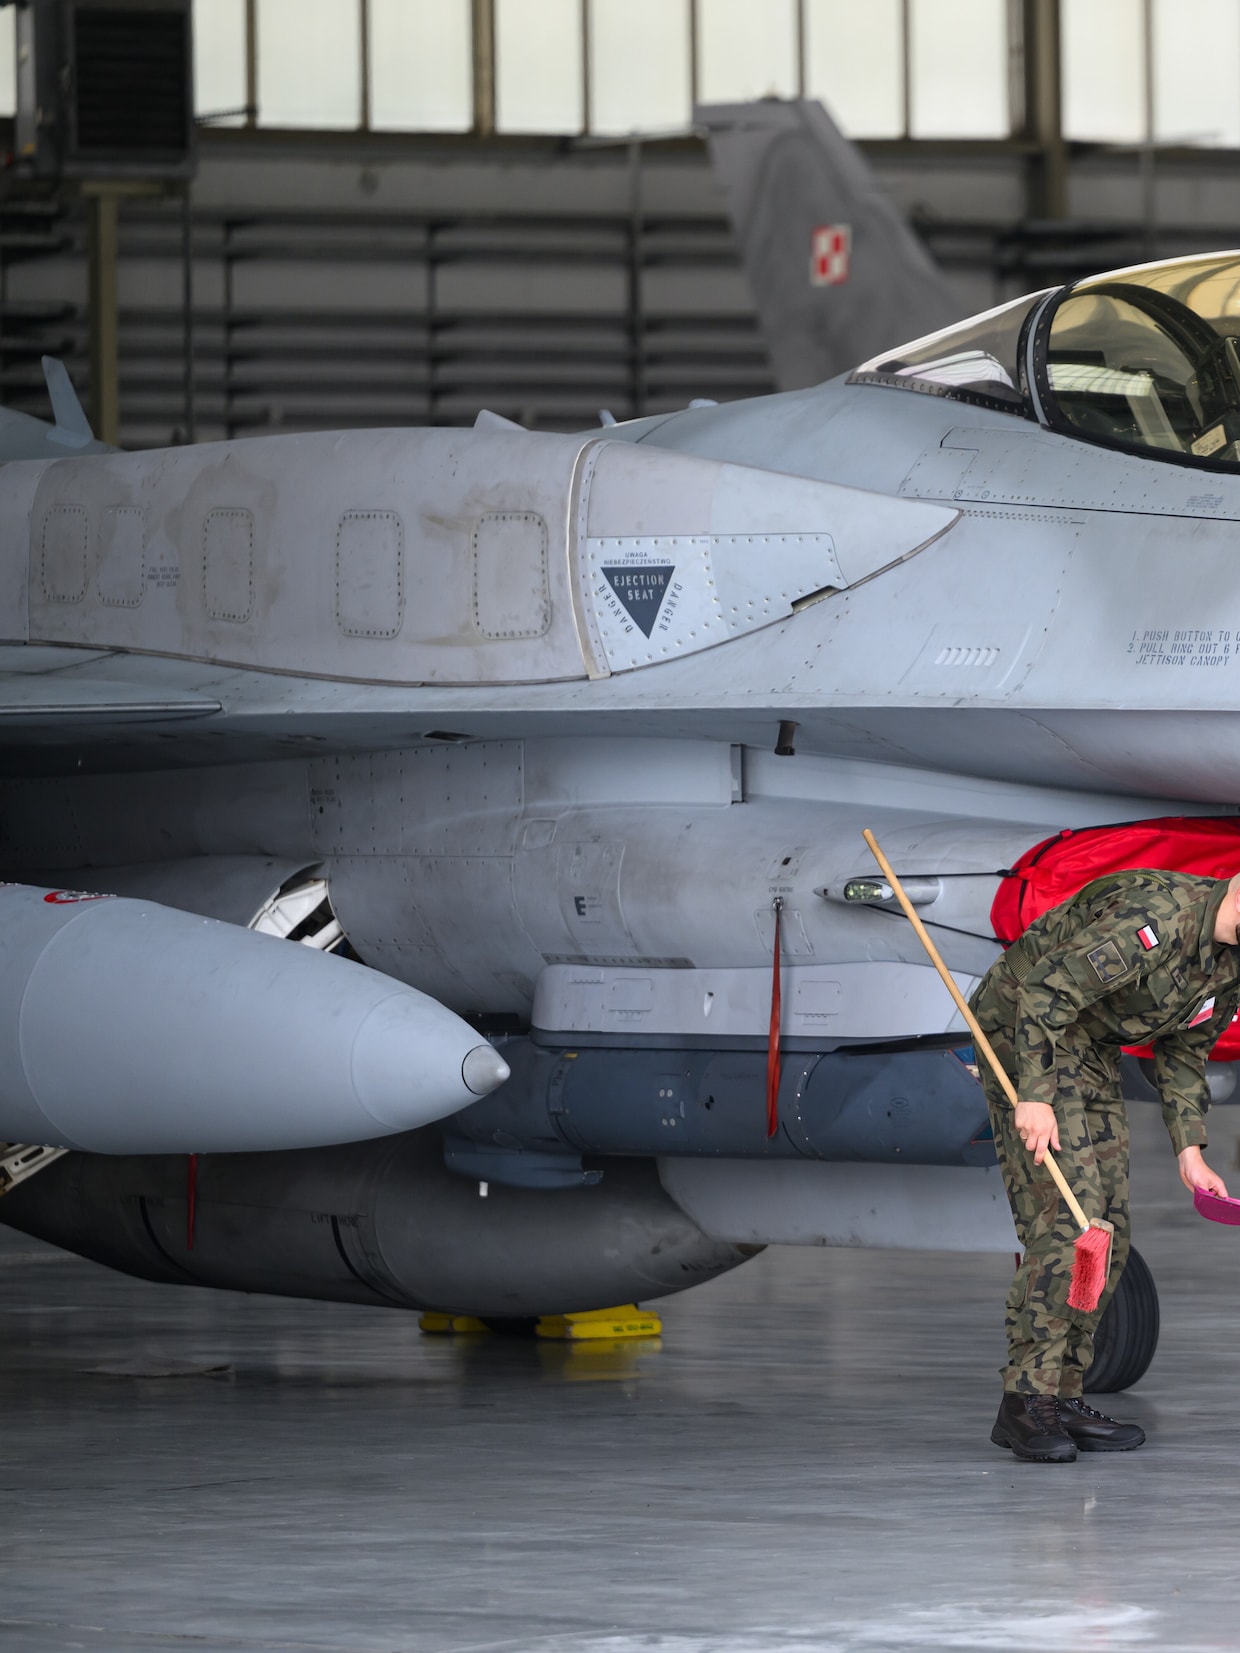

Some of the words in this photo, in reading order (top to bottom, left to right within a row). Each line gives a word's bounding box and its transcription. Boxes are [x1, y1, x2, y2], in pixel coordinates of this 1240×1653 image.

[625, 551, 648, 559] UWAGA
[614, 575, 664, 587] EJECTION
[628, 589, 654, 600] SEAT
[598, 583, 634, 634] DANGER
[658, 582, 683, 631] DANGER
[1132, 631, 1140, 642] 1.
[1142, 631, 1169, 642] PUSH
[1174, 631, 1212, 642] BUTTON
[1219, 630, 1230, 642] TO
[1127, 643, 1136, 653] 2.
[1139, 643, 1164, 654] PULL
[1171, 643, 1193, 654] RING
[1199, 643, 1218, 654] OUT
[1224, 643, 1230, 654] 6
[1136, 655, 1185, 666] JETTISON
[1190, 655, 1230, 666] CANOPY
[574, 896, 586, 916] E
